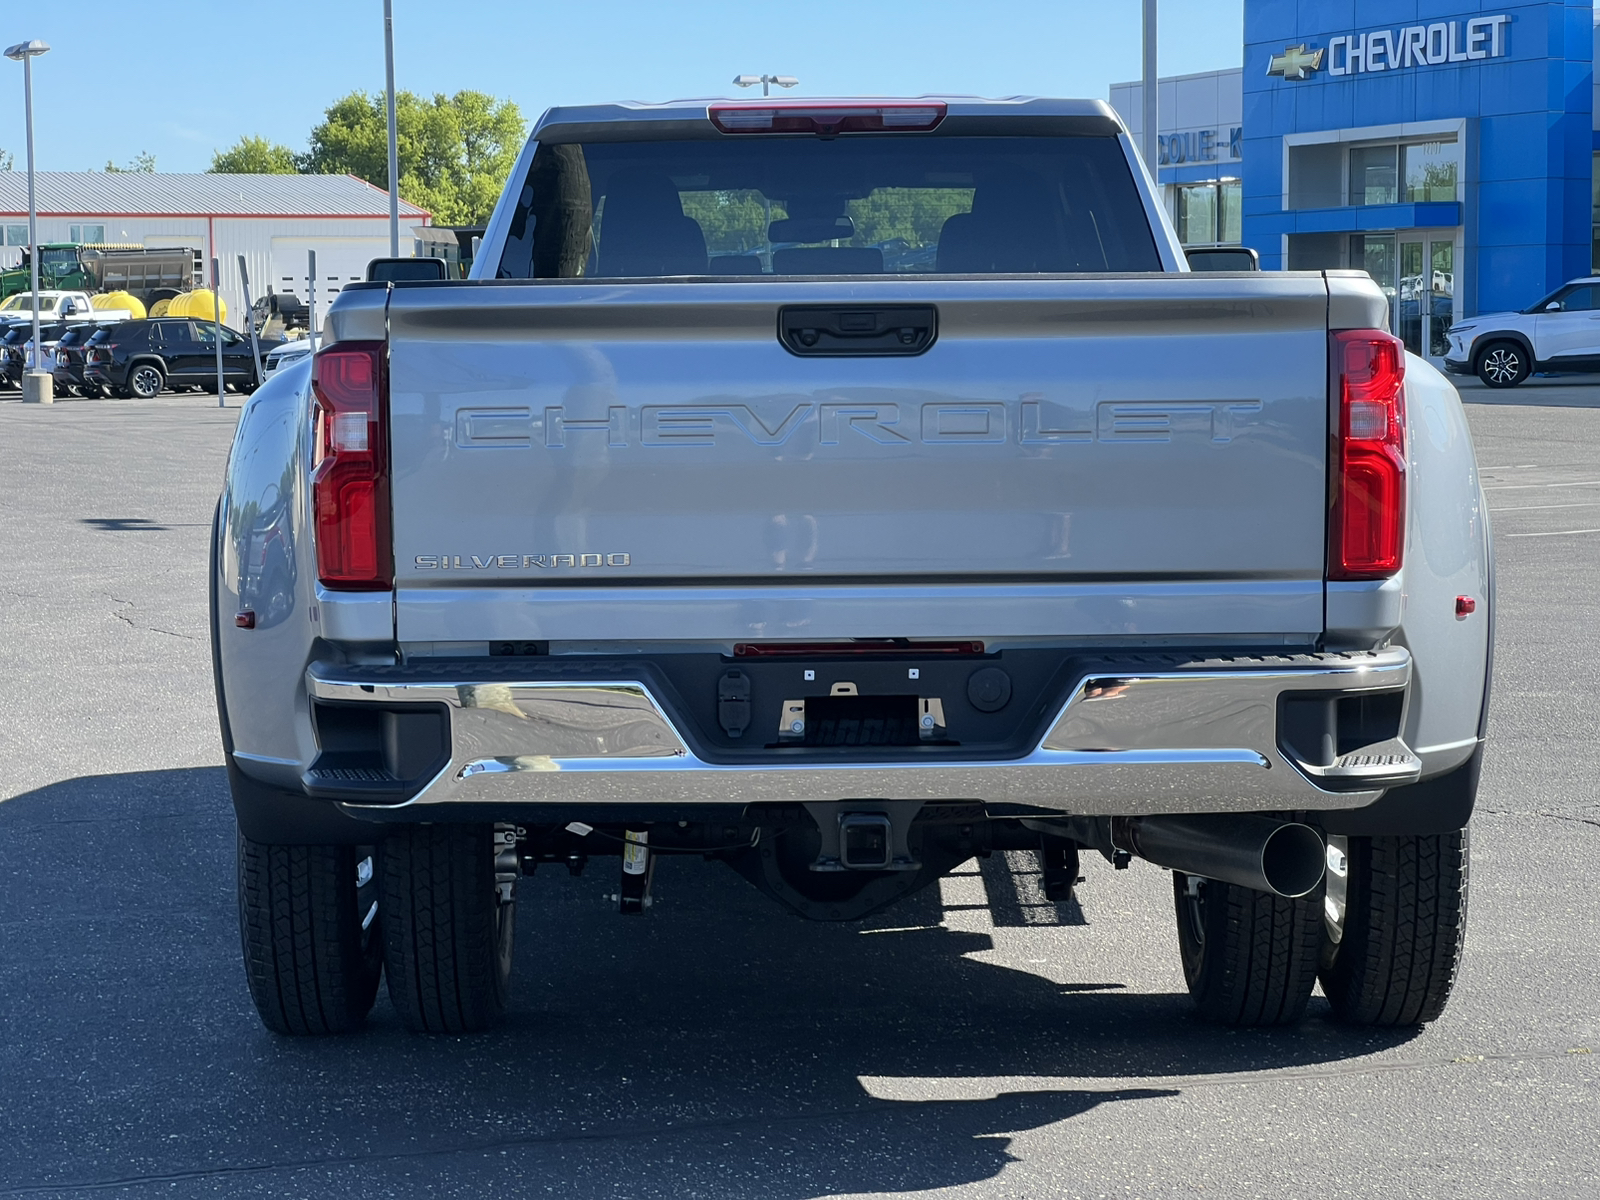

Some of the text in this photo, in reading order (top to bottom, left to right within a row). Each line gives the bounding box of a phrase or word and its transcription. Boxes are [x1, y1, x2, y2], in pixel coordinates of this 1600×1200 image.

[1328, 15, 1509, 76] CHEVROLET
[455, 400, 1263, 450] CHEVROLET
[414, 552, 631, 570] SILVERADO
